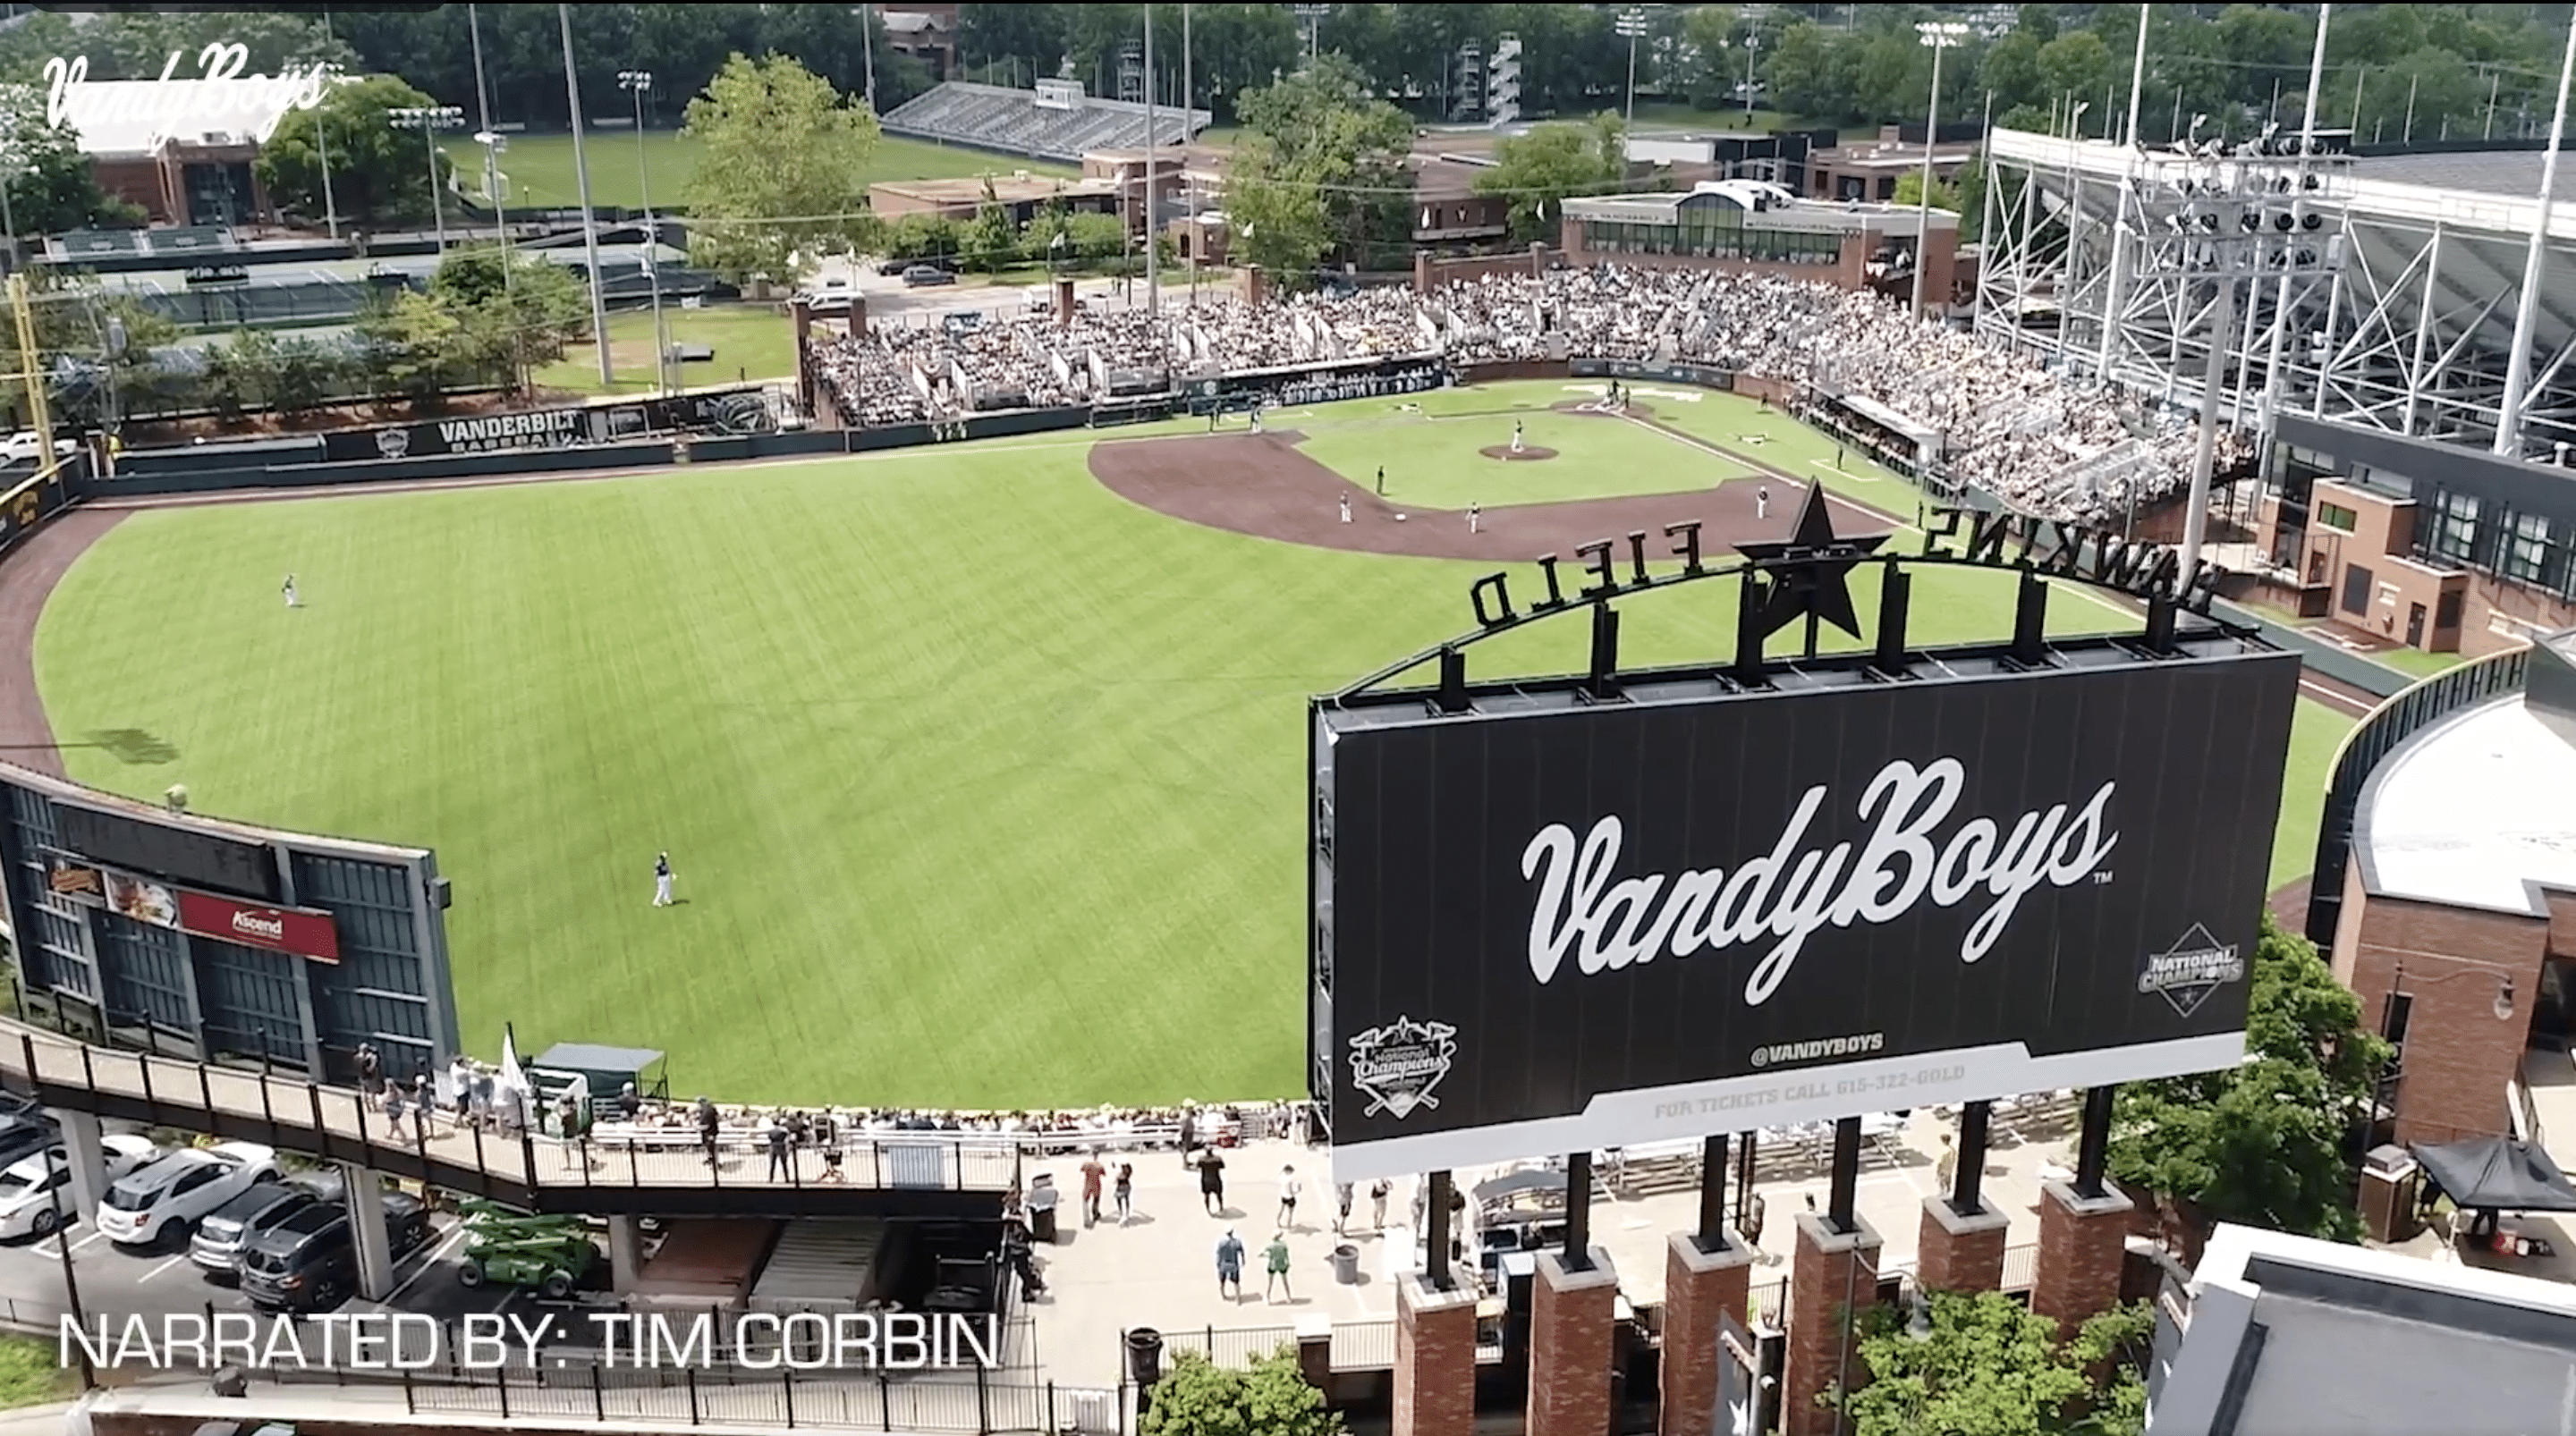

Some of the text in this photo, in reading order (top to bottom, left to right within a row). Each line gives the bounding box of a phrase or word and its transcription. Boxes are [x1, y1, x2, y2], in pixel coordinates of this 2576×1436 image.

[438, 410, 577, 443] VANDERBILT
[1521, 756, 2119, 1006] VandyBoys
[2093, 871, 2114, 883] TM
[233, 910, 283, 936] Ascend
[2150, 948, 2235, 973] NATIONAL
[1750, 1033, 1884, 1068] @VANDYBOYS
[1360, 1057, 1445, 1081] Champions
[1656, 1064, 1966, 1119] FOR TICKETS CALL 615-322-GOLD
